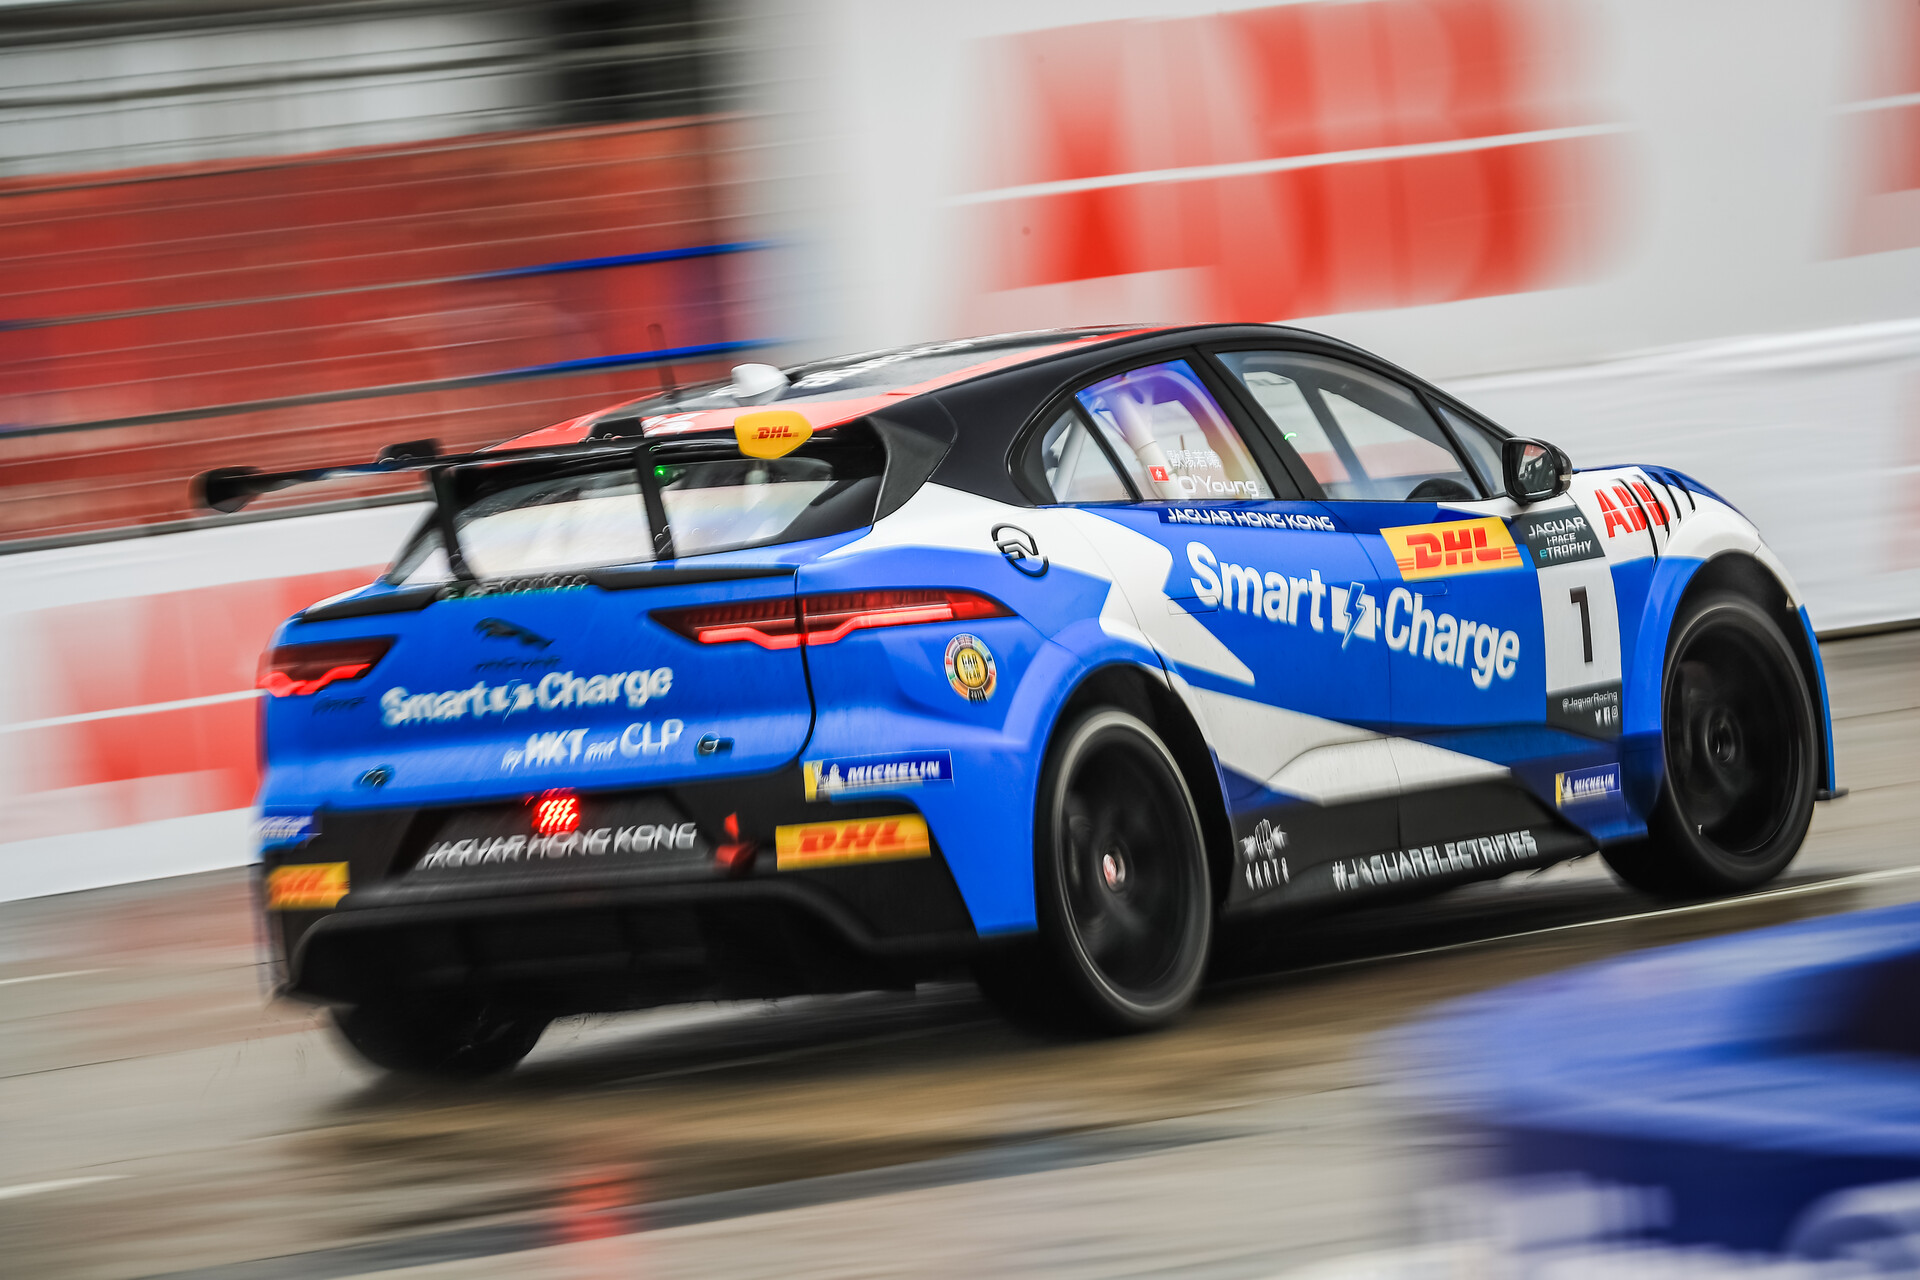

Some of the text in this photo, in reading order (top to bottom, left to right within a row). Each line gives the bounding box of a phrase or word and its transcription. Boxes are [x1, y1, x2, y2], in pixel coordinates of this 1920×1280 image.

[757, 426, 792, 439] DHL
[1178, 474, 1259, 497] O'Young
[1168, 508, 1335, 531] JAGUAR HONG KONG
[1594, 482, 1671, 538] ABB
[1528, 516, 1587, 540] JAGUAR
[1406, 527, 1501, 569] DHL
[1539, 540, 1592, 560] eTROPHY
[1186, 541, 1520, 690] Smart Charge
[1570, 586, 1593, 663] 1
[380, 685, 488, 727] Smart
[536, 666, 673, 711] Charge
[1562, 691, 1618, 712] @JaguarRacing
[619, 718, 684, 758] CLP
[847, 760, 940, 782] MICHELIN
[1574, 773, 1614, 792] MICHELIN
[415, 822, 697, 871] JAGUAR HONG KONG
[799, 820, 910, 853] DHL
[1332, 830, 1538, 891] #JAGUARELECTRIFIES
